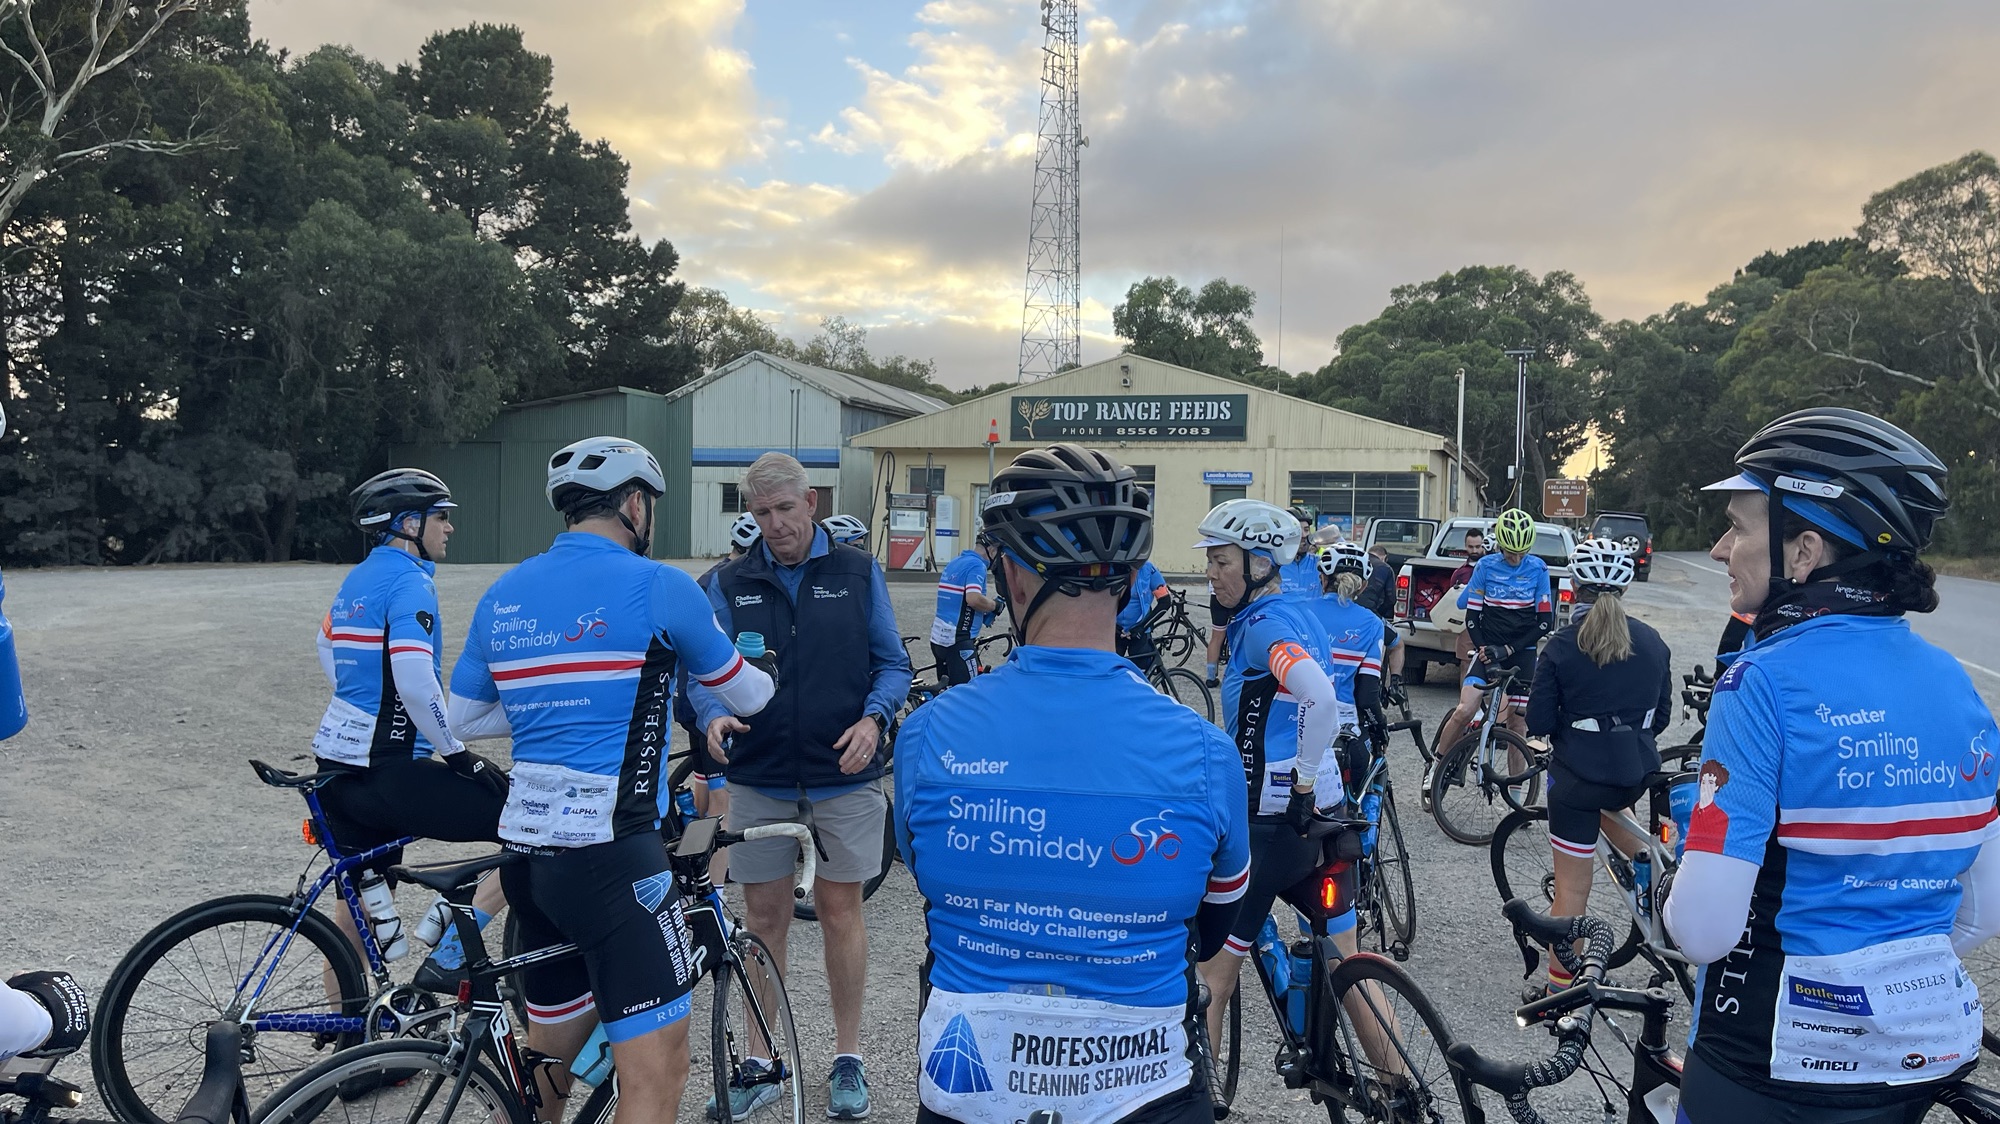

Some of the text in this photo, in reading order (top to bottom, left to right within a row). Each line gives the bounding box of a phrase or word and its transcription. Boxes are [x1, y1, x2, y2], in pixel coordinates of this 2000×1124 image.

[1051, 401, 1231, 421] TOP RANGE FEEDS
[1062, 427, 1211, 436] PHONE 8556 7083
[1791, 480, 1806, 491] LIZ
[496, 604, 522, 615] mater
[491, 616, 537, 634] Smiling
[491, 631, 561, 652] for Smiddy
[429, 702, 447, 729] mater
[527, 700, 551, 710] cancer
[551, 697, 591, 708] research
[1298, 706, 1307, 741] mater
[1830, 708, 1886, 728] mater
[1837, 732, 1919, 760] Smiling
[951, 758, 1009, 775] mater
[1837, 761, 1957, 790] for Smiddy
[521, 799, 550, 809] Challenge
[569, 807, 598, 816] ALPHA
[949, 795, 1046, 833] Smiling
[947, 826, 1103, 868] for Smiddy
[1901, 877, 1950, 890] cancer
[944, 893, 1167, 924] 2021 Far North Queensland
[670, 900, 693, 979] PROFESSIONAL
[979, 914, 1129, 942] Smiddy Challenge
[656, 910, 687, 986] CLEANING SERVICES
[957, 934, 1158, 965] Funding cancer research
[63, 975, 88, 1013] Tropics
[1795, 983, 1864, 1003] Bottlemart
[1884, 973, 1946, 995] RUSSELLS
[52, 976, 83, 1031] Challenge
[1792, 1021, 1863, 1035] POWERADE
[1010, 1026, 1170, 1067] PROFESSIONAL
[1008, 1060, 1168, 1097] CLEANING SERVICES
